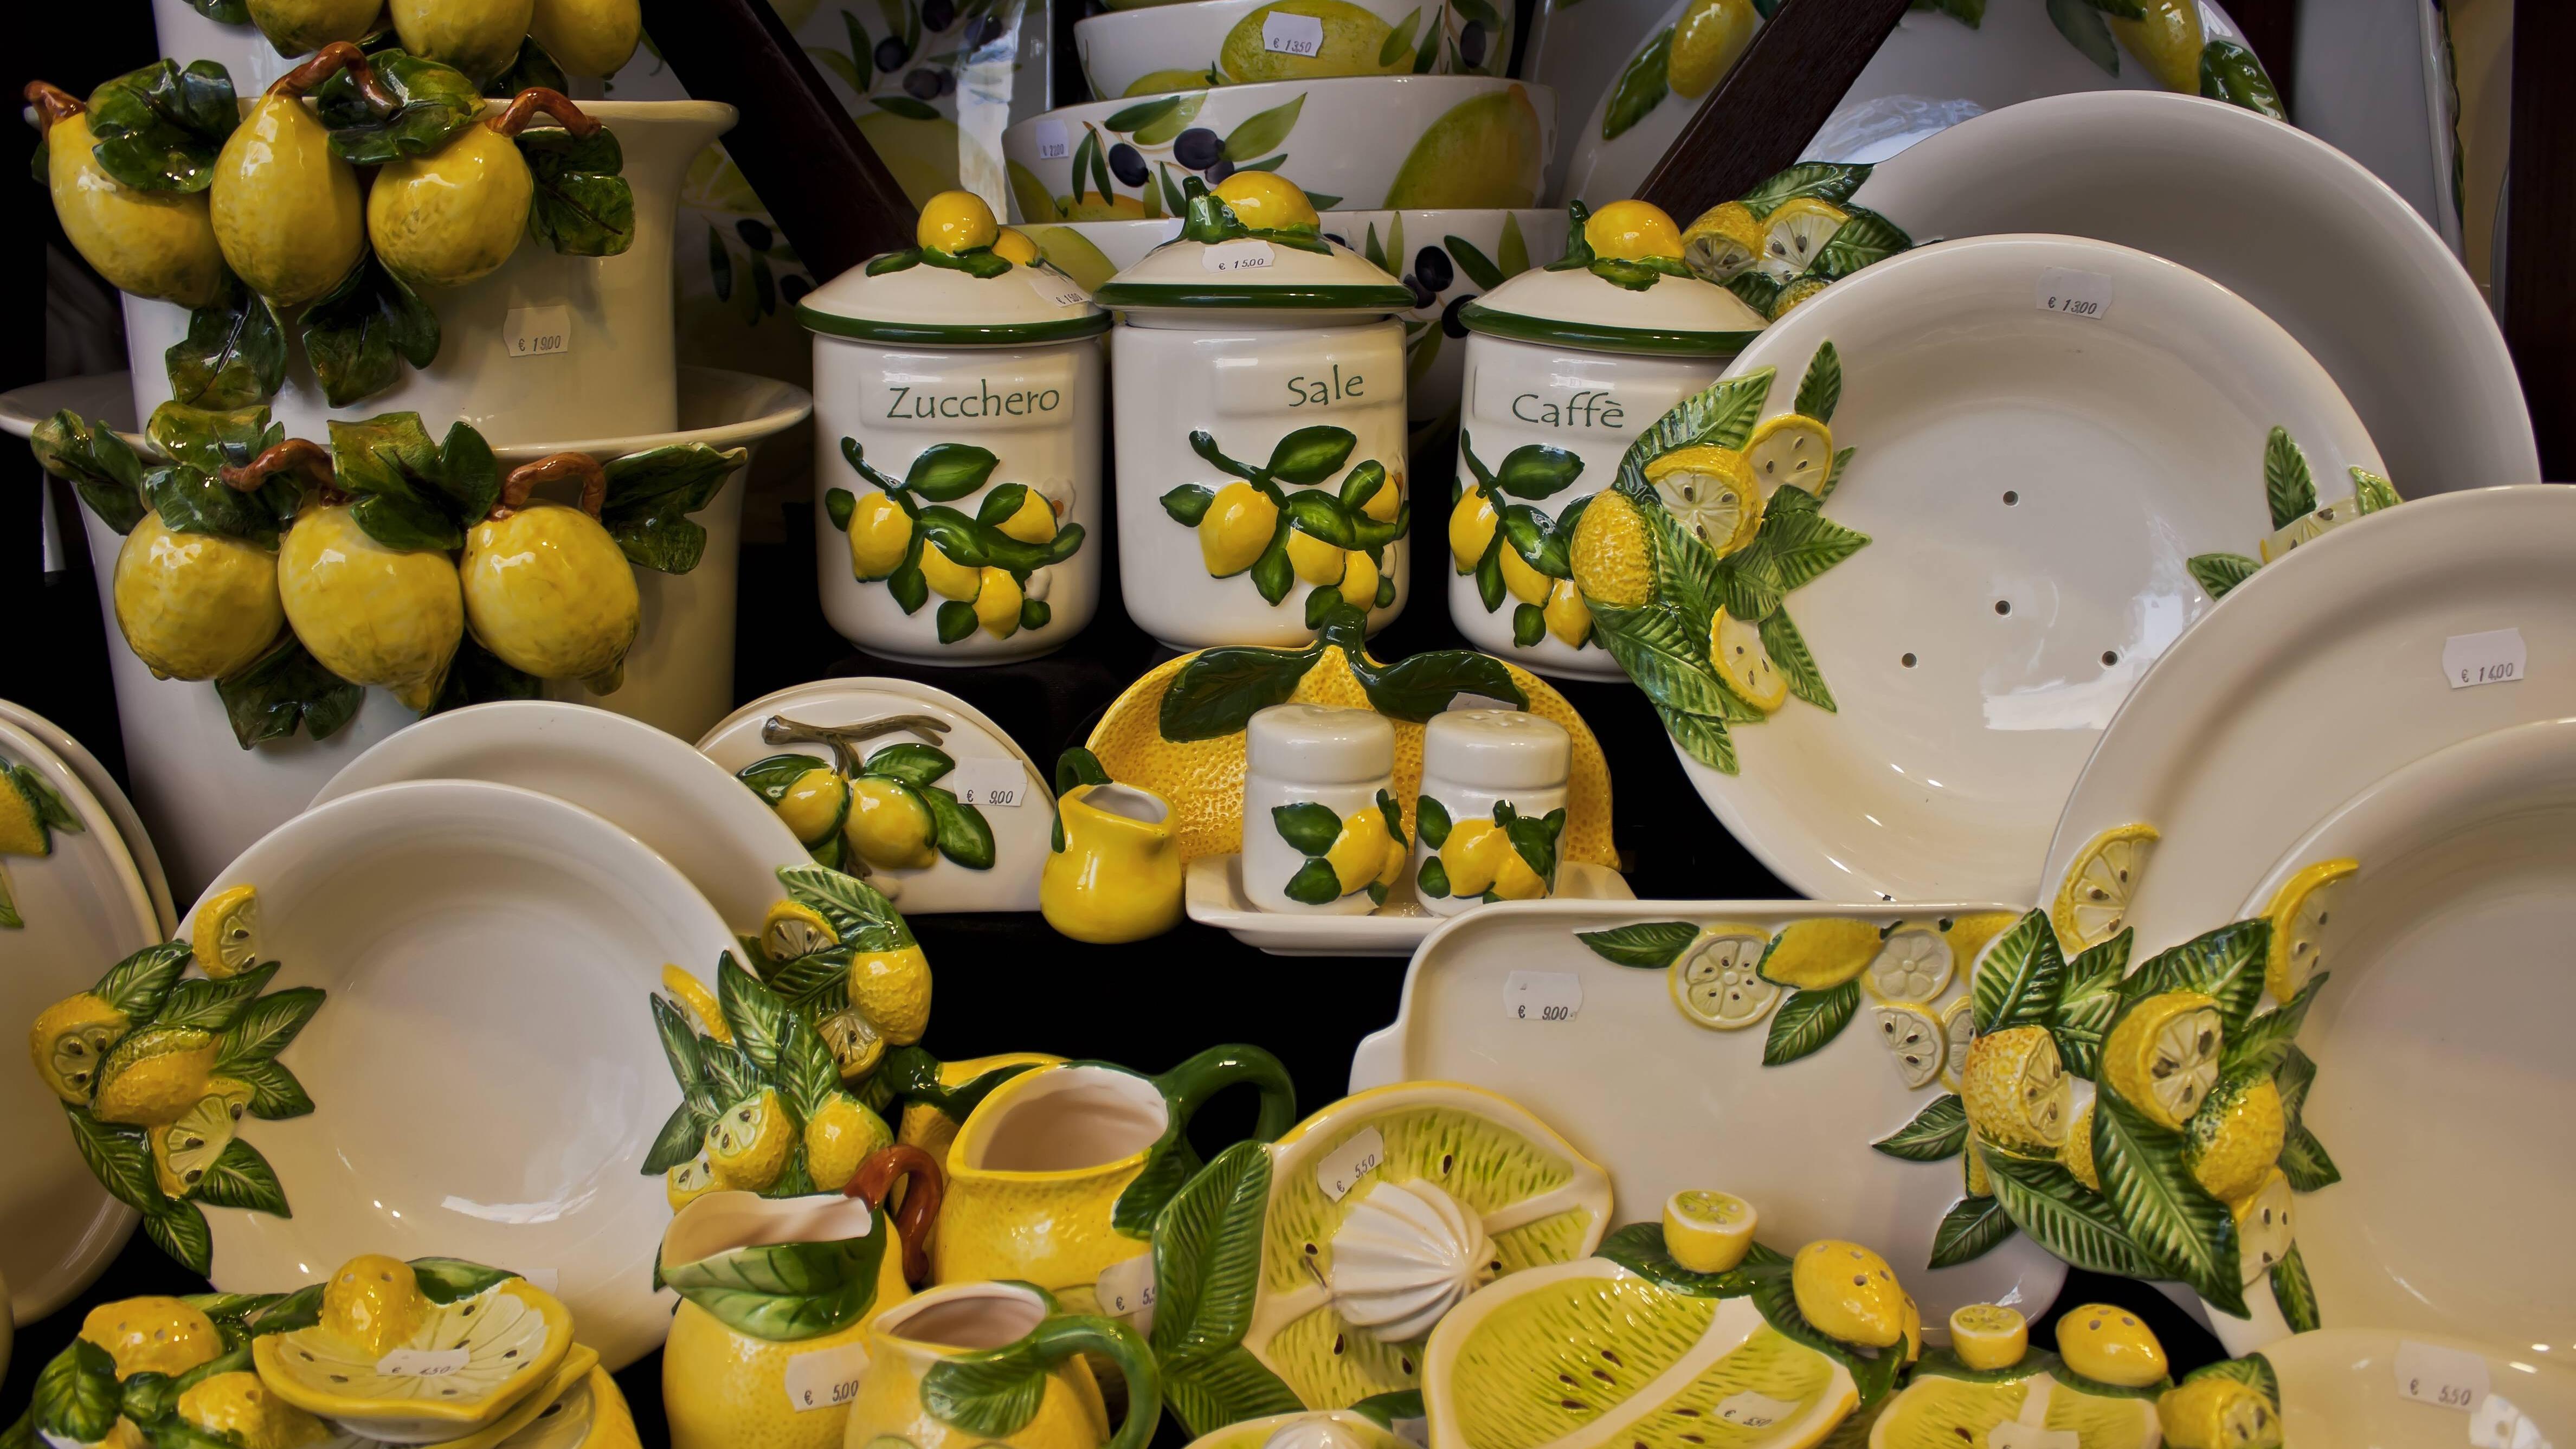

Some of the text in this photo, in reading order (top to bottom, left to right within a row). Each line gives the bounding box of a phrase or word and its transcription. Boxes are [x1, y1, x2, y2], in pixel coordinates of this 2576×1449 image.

[886, 378, 1060, 419] Zucchero
[1287, 364, 1364, 407] Sale
[1512, 391, 1624, 428] Caffè
